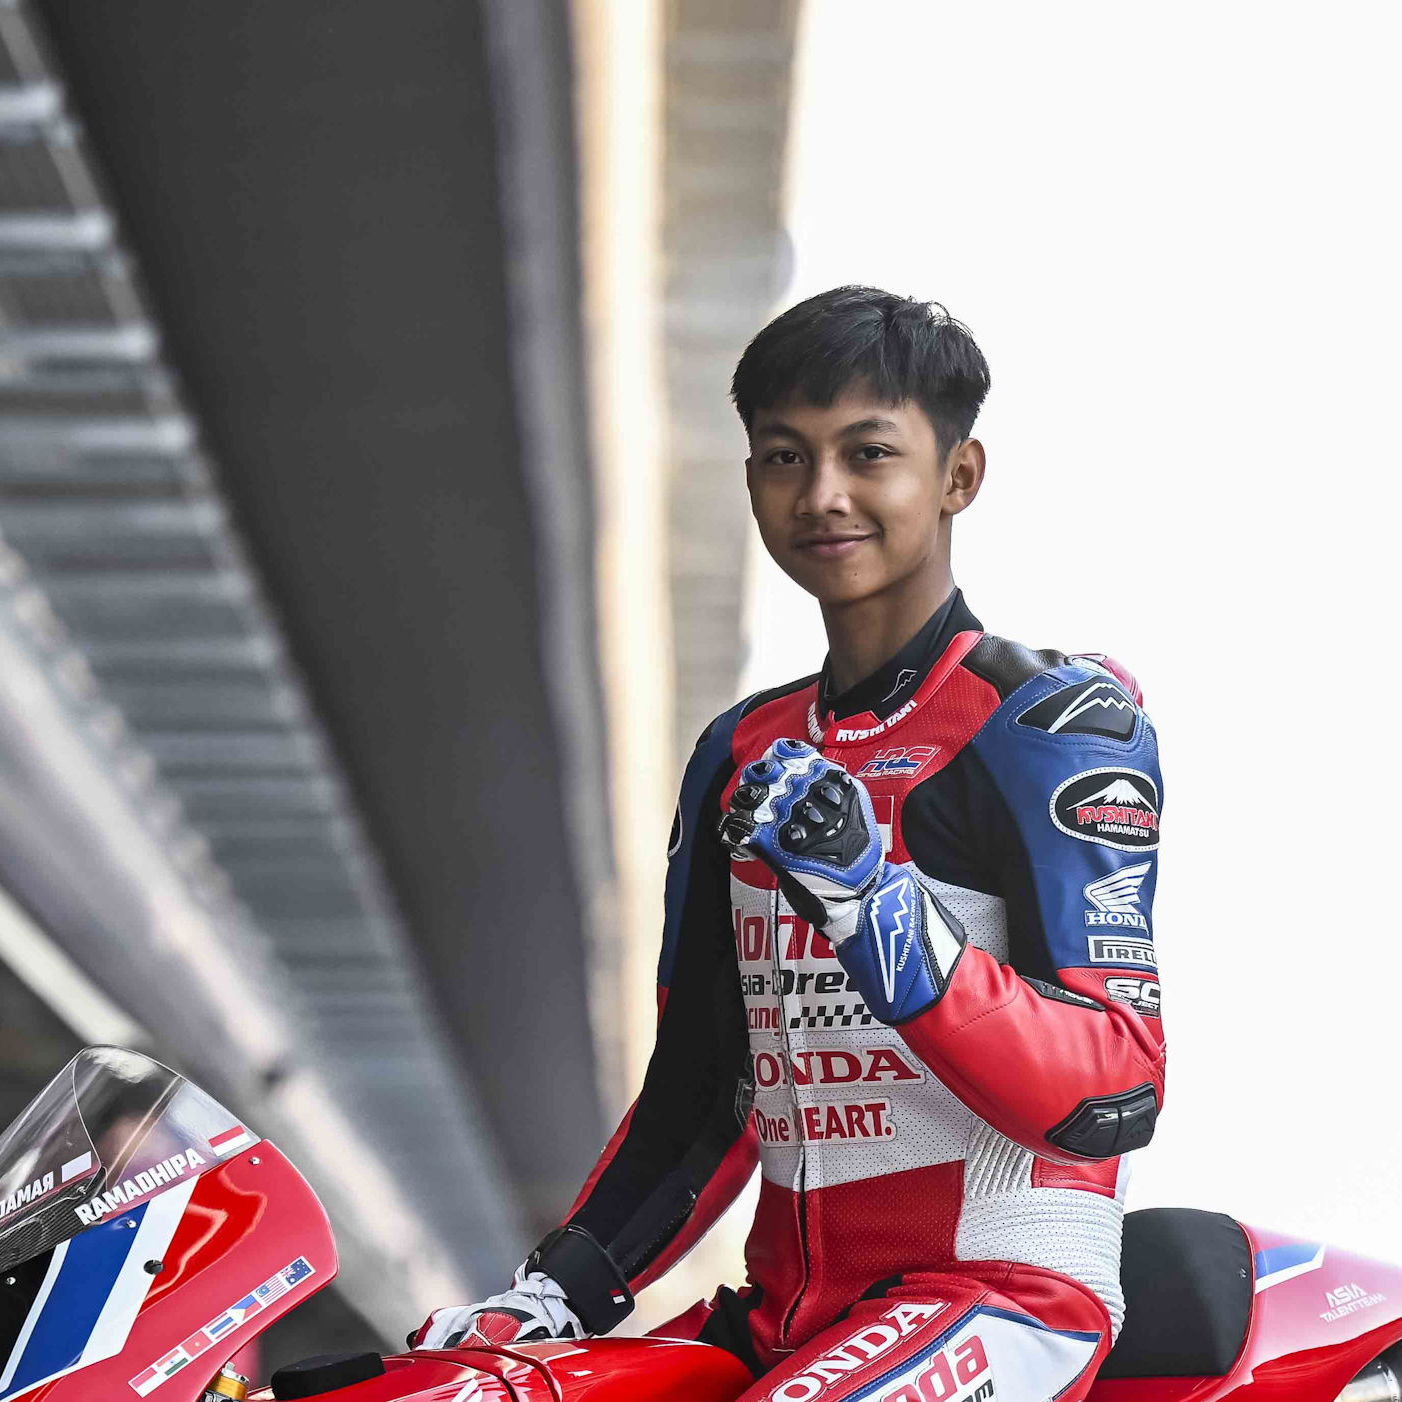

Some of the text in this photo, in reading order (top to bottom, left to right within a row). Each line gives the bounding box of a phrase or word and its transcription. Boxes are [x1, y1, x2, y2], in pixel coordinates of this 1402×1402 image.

[1097, 823, 1150, 838] HAMAMATSU
[896, 929, 915, 972] KUSHITANI
[909, 903, 917, 928] RACING
[751, 1049, 922, 1088] ONDA
[755, 1107, 790, 1142] One
[74, 1148, 207, 1226] RAMADHIPA
[1325, 1282, 1368, 1308] ASIA
